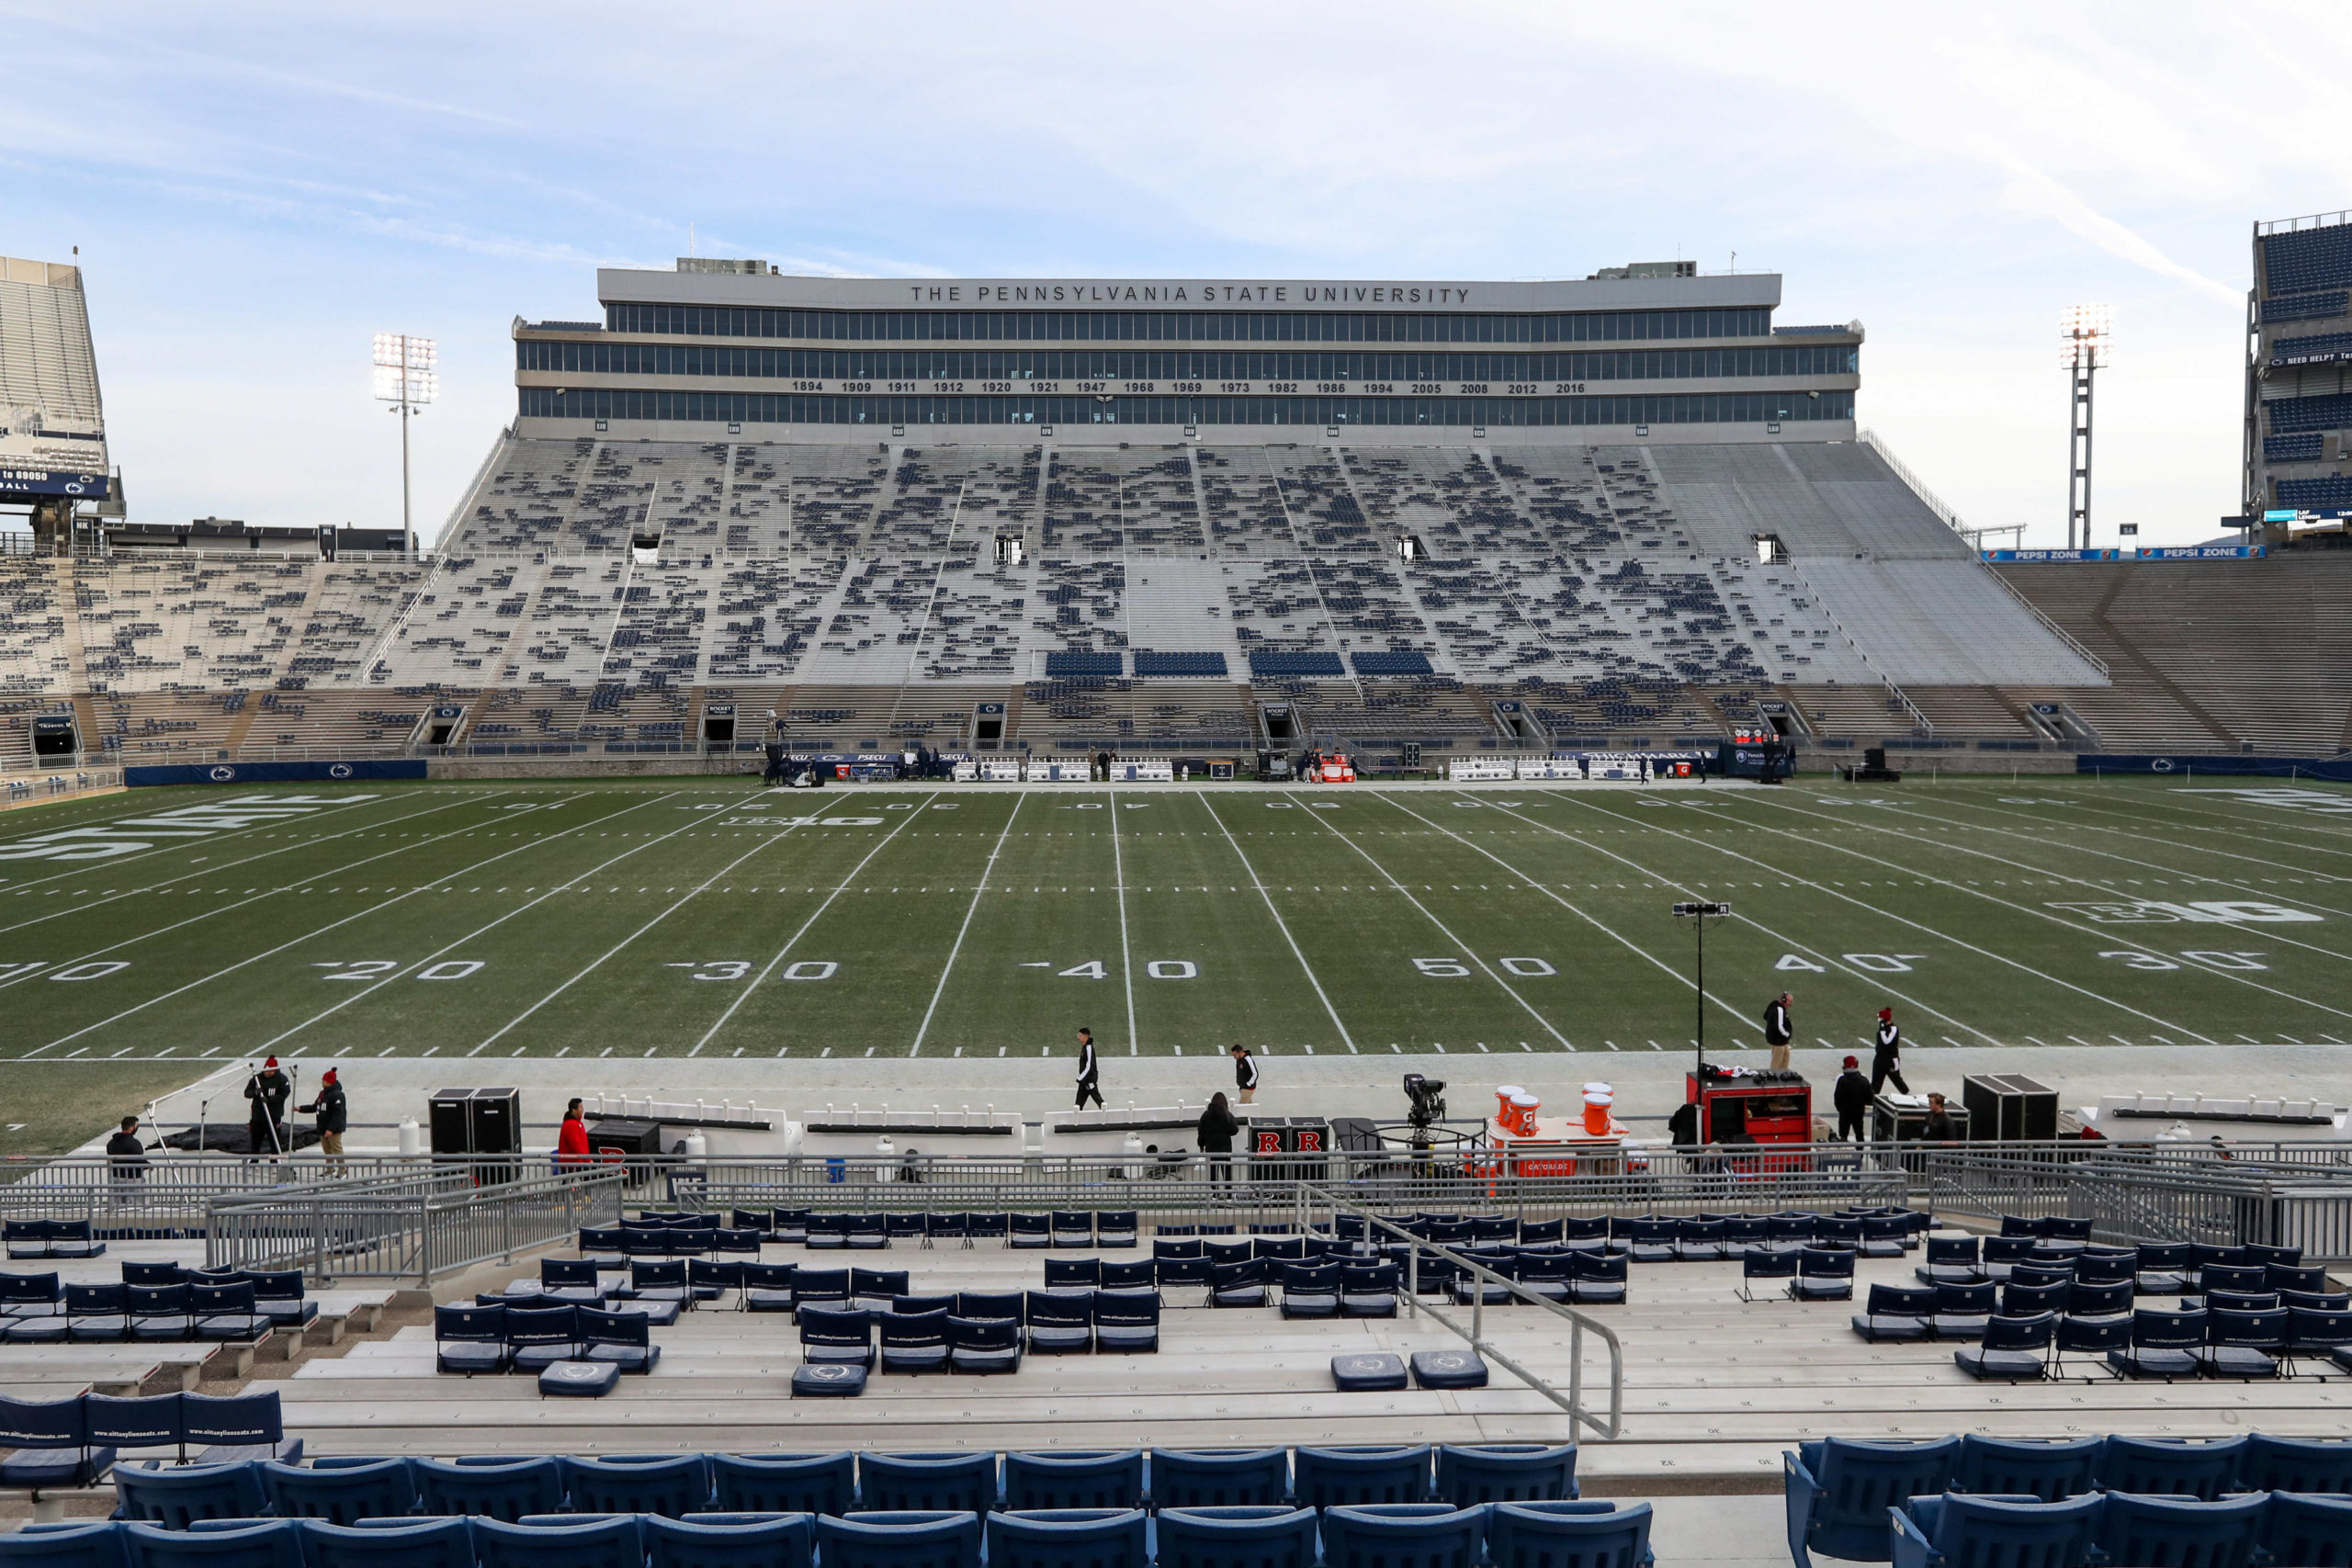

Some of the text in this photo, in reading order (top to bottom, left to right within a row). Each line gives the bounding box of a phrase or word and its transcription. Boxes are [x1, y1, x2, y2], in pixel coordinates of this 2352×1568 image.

[911, 286, 1470, 302] THE PENNSYLVANIA STATE UNIVERSITY
[2287, 356, 2307, 365] NEED
[2310, 354, 2335, 363] HELP?
[793, 381, 1585, 393] 1894 1909 1911 1912 1920 1921 1947 1968 1969 1973 1982 1986 1994 2005 2008 2012 2016
[3, 470, 13, 479] to
[2015, 551, 2081, 560] PEPSI ZONE
[2164, 547, 2237, 558] PEPSI ZONE
[1682, 765, 1689, 773] G
[2166, 787, 2352, 813] PE
[0, 794, 381, 861] STATE
[1411, 957, 1557, 976] 50
[1774, 953, 1914, 973] 40
[2098, 951, 2269, 970] 30
[322, 961, 486, 979] 20
[693, 961, 839, 980] 30
[1057, 961, 1197, 979] 40
[1522, 1111, 1533, 1122] G
[1258, 1132, 1281, 1153] R
[1298, 1131, 1321, 1153] R
[95, 1429, 170, 1438] www.nittanylionseats.com
[189, 1428, 264, 1437] www.nittanylionseats.com
[1660, 1459, 1676, 1467] 32
[1758, 1458, 1774, 1467] 30
